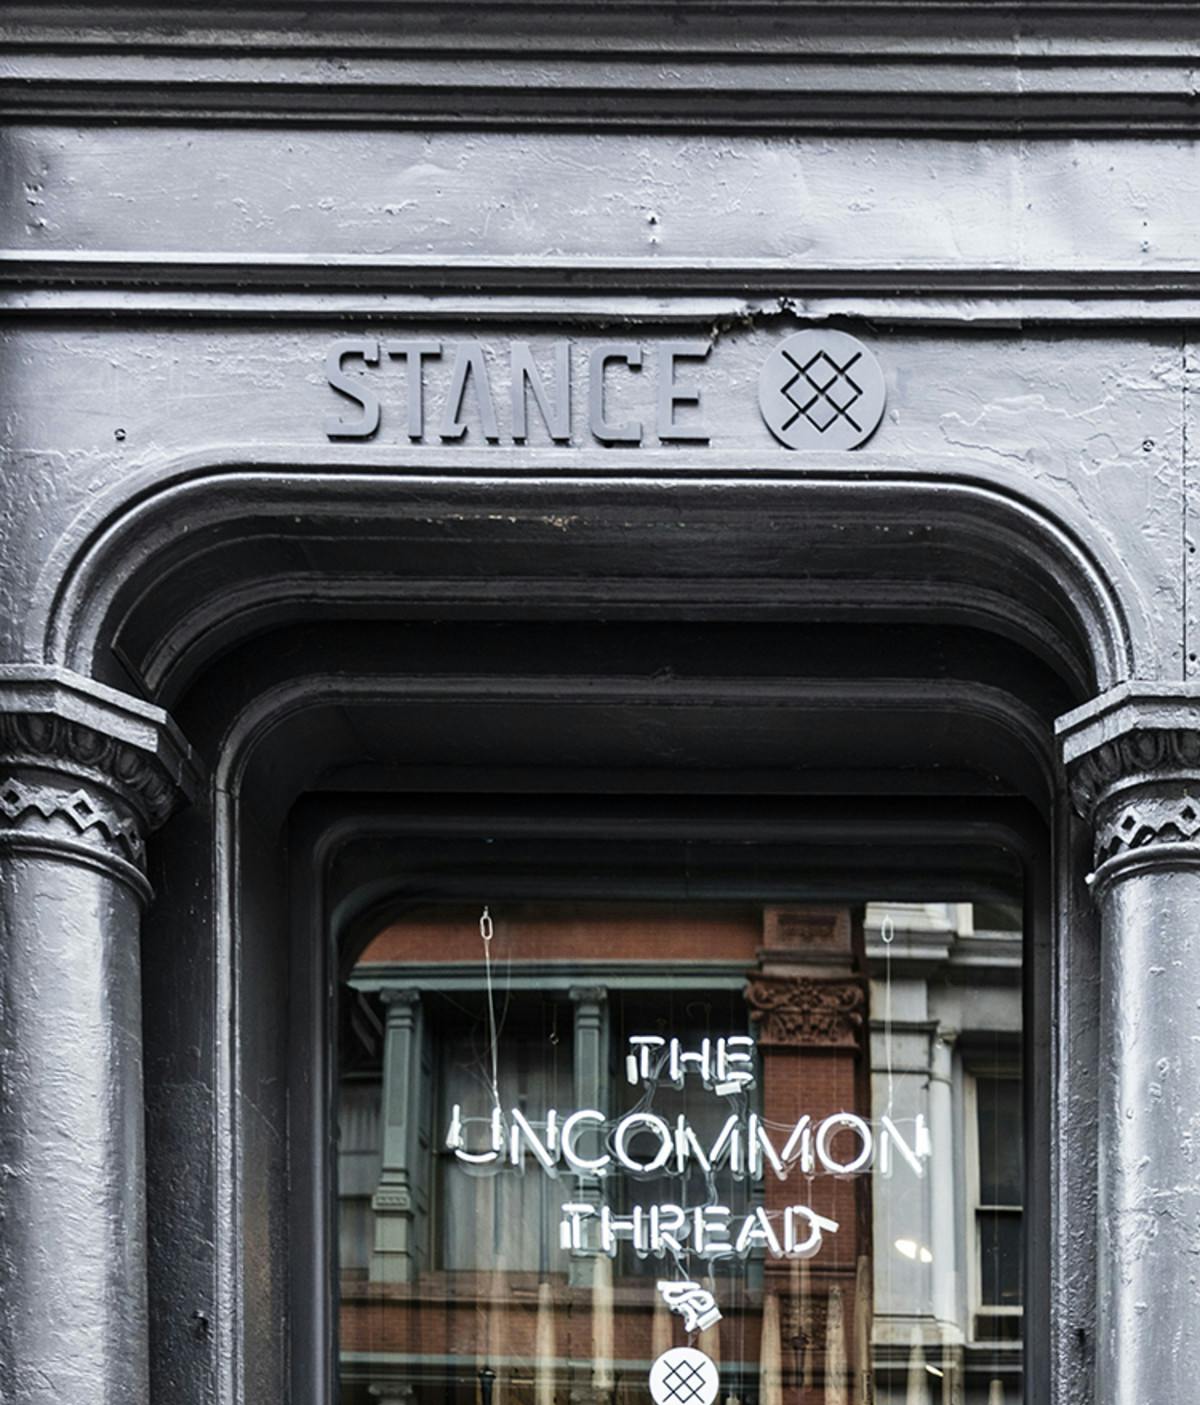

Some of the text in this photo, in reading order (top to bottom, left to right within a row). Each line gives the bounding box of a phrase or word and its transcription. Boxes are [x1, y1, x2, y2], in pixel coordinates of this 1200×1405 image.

[326, 341, 713, 446] STANCE
[628, 1036, 754, 1082] THE
[446, 1103, 932, 1179] UNCOMMON
[560, 1203, 838, 1253] THREAD
